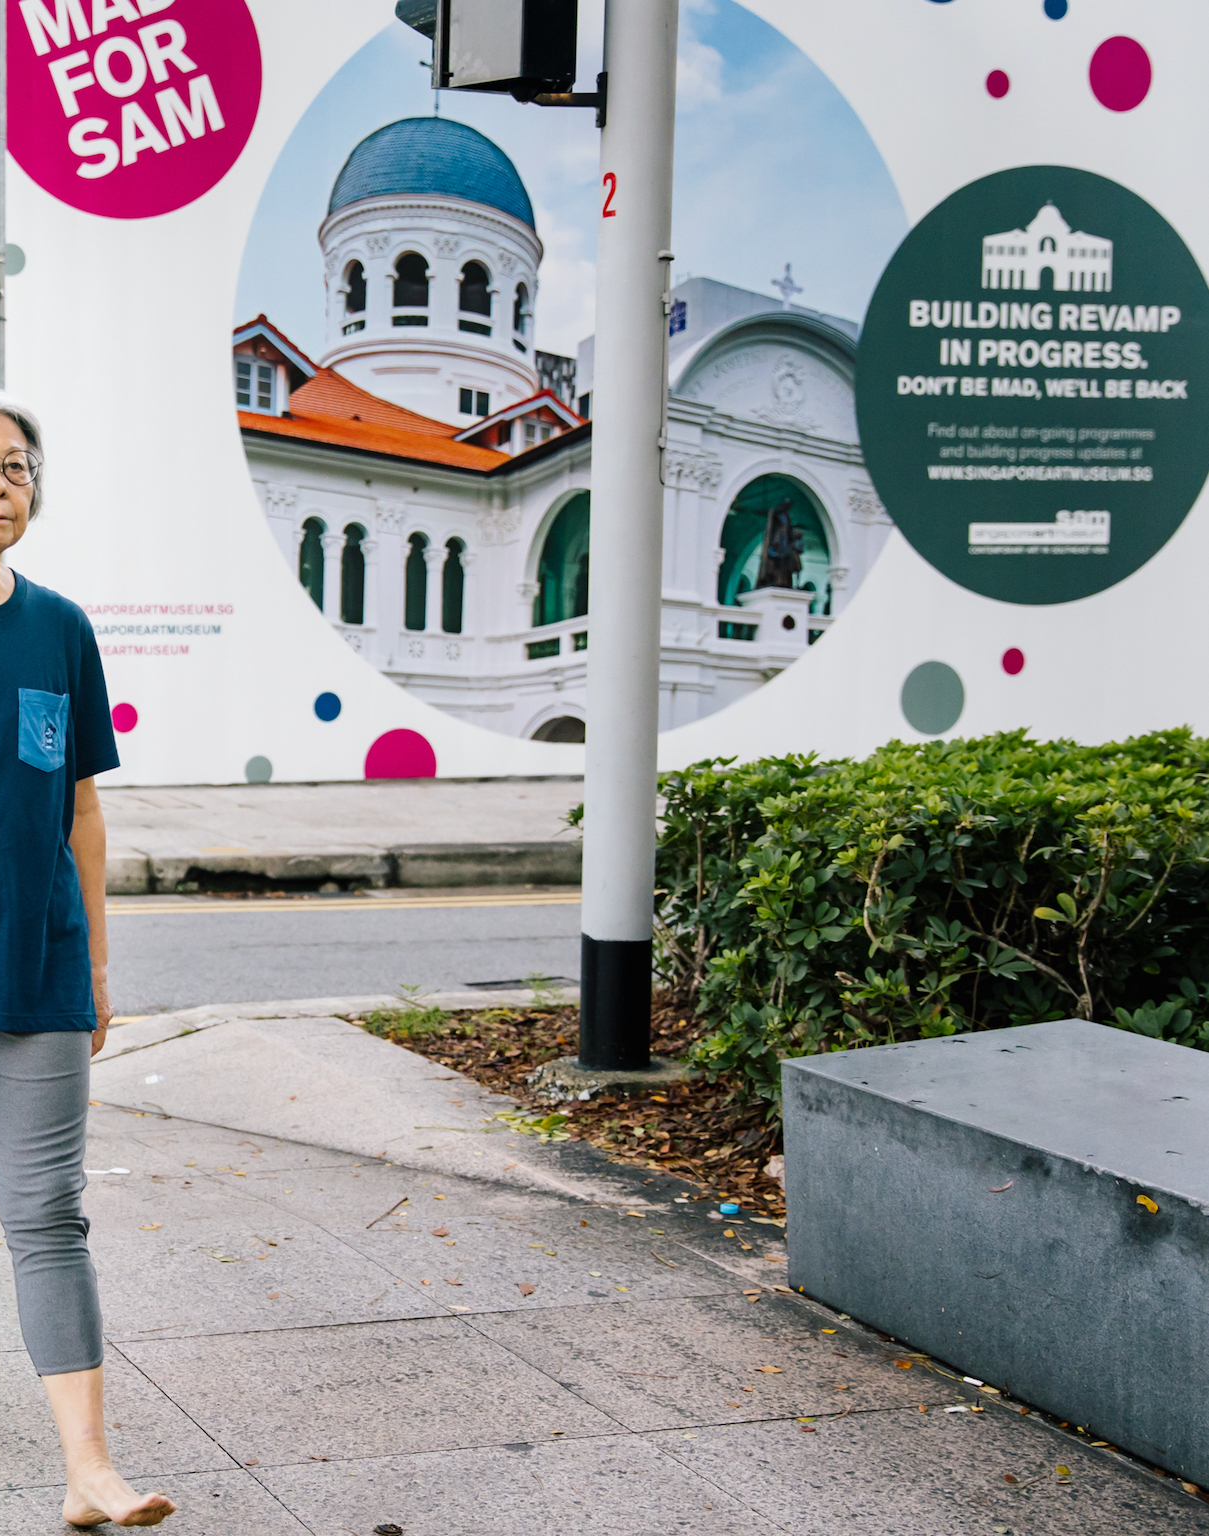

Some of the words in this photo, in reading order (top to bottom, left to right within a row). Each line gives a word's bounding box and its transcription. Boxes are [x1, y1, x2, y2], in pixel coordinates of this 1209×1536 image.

[48, 19, 198, 118] FOR
[68, 74, 225, 179] SAM
[602, 172, 617, 218] 2
[909, 300, 1053, 331] BUILDING
[1059, 304, 1181, 332] REVAMP
[940, 339, 971, 366] IN
[978, 340, 1148, 369] PROGRESS.
[897, 376, 958, 396] DON'T
[960, 377, 988, 396] BE
[992, 378, 1041, 399] MAD,
[1045, 378, 1102, 398] WE'LL
[1104, 379, 1133, 398] BE
[1135, 380, 1188, 399] BACK
[927, 422, 956, 438] Find
[958, 425, 980, 438] out
[981, 424, 1019, 439] about
[1020, 425, 1077, 443] on-going
[1078, 427, 1156, 443] programmes
[939, 445, 966, 459] and
[966, 444, 1018, 462] building
[1018, 447, 1076, 462] progress
[1076, 447, 1128, 462] updates
[1128, 447, 1143, 459] at
[82, 604, 234, 615] GAPOREARTMUSEUM.SG
[93, 624, 222, 636] GAPOREARTMUSEUM
